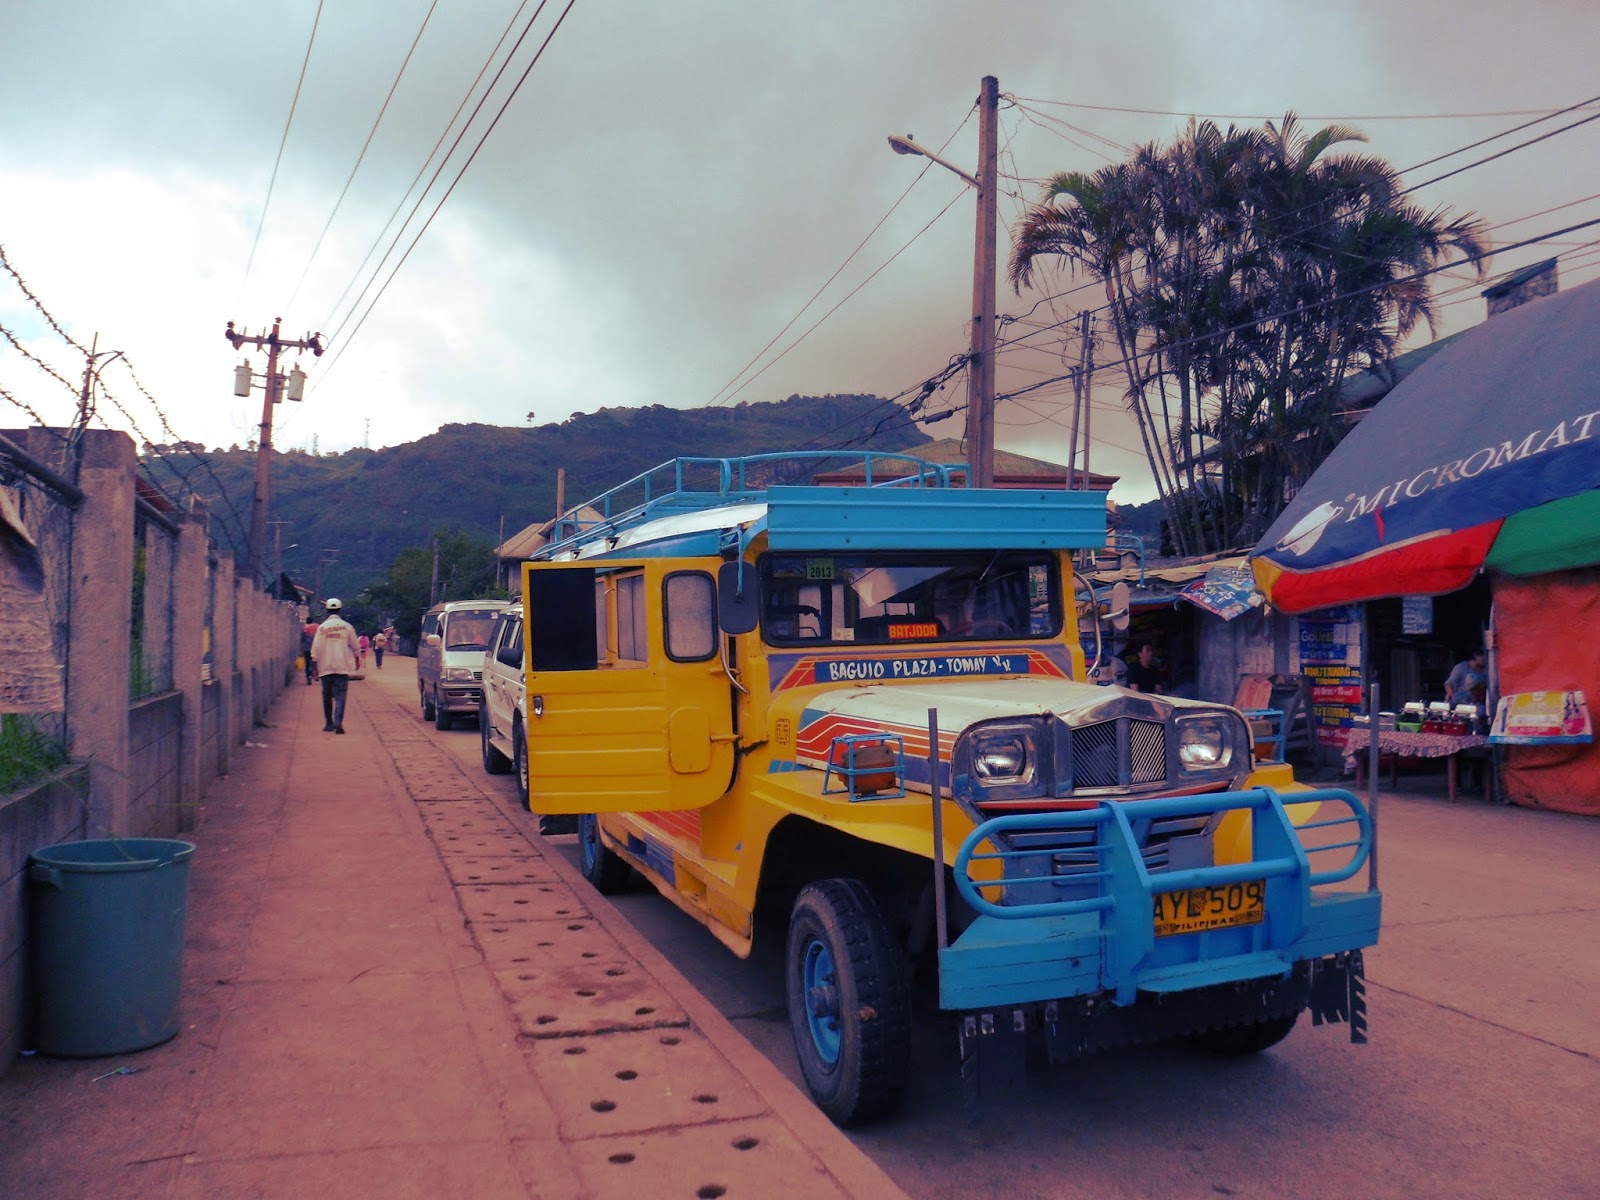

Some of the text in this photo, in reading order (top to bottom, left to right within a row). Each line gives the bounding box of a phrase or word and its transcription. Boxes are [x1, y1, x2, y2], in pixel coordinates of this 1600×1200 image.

[1345, 411, 1600, 523] MICROMAT
[810, 567, 832, 578] 2013
[888, 624, 938, 639] BATJODA
[829, 661, 885, 681] BAGUIO
[1209, 882, 1262, 914] 509
